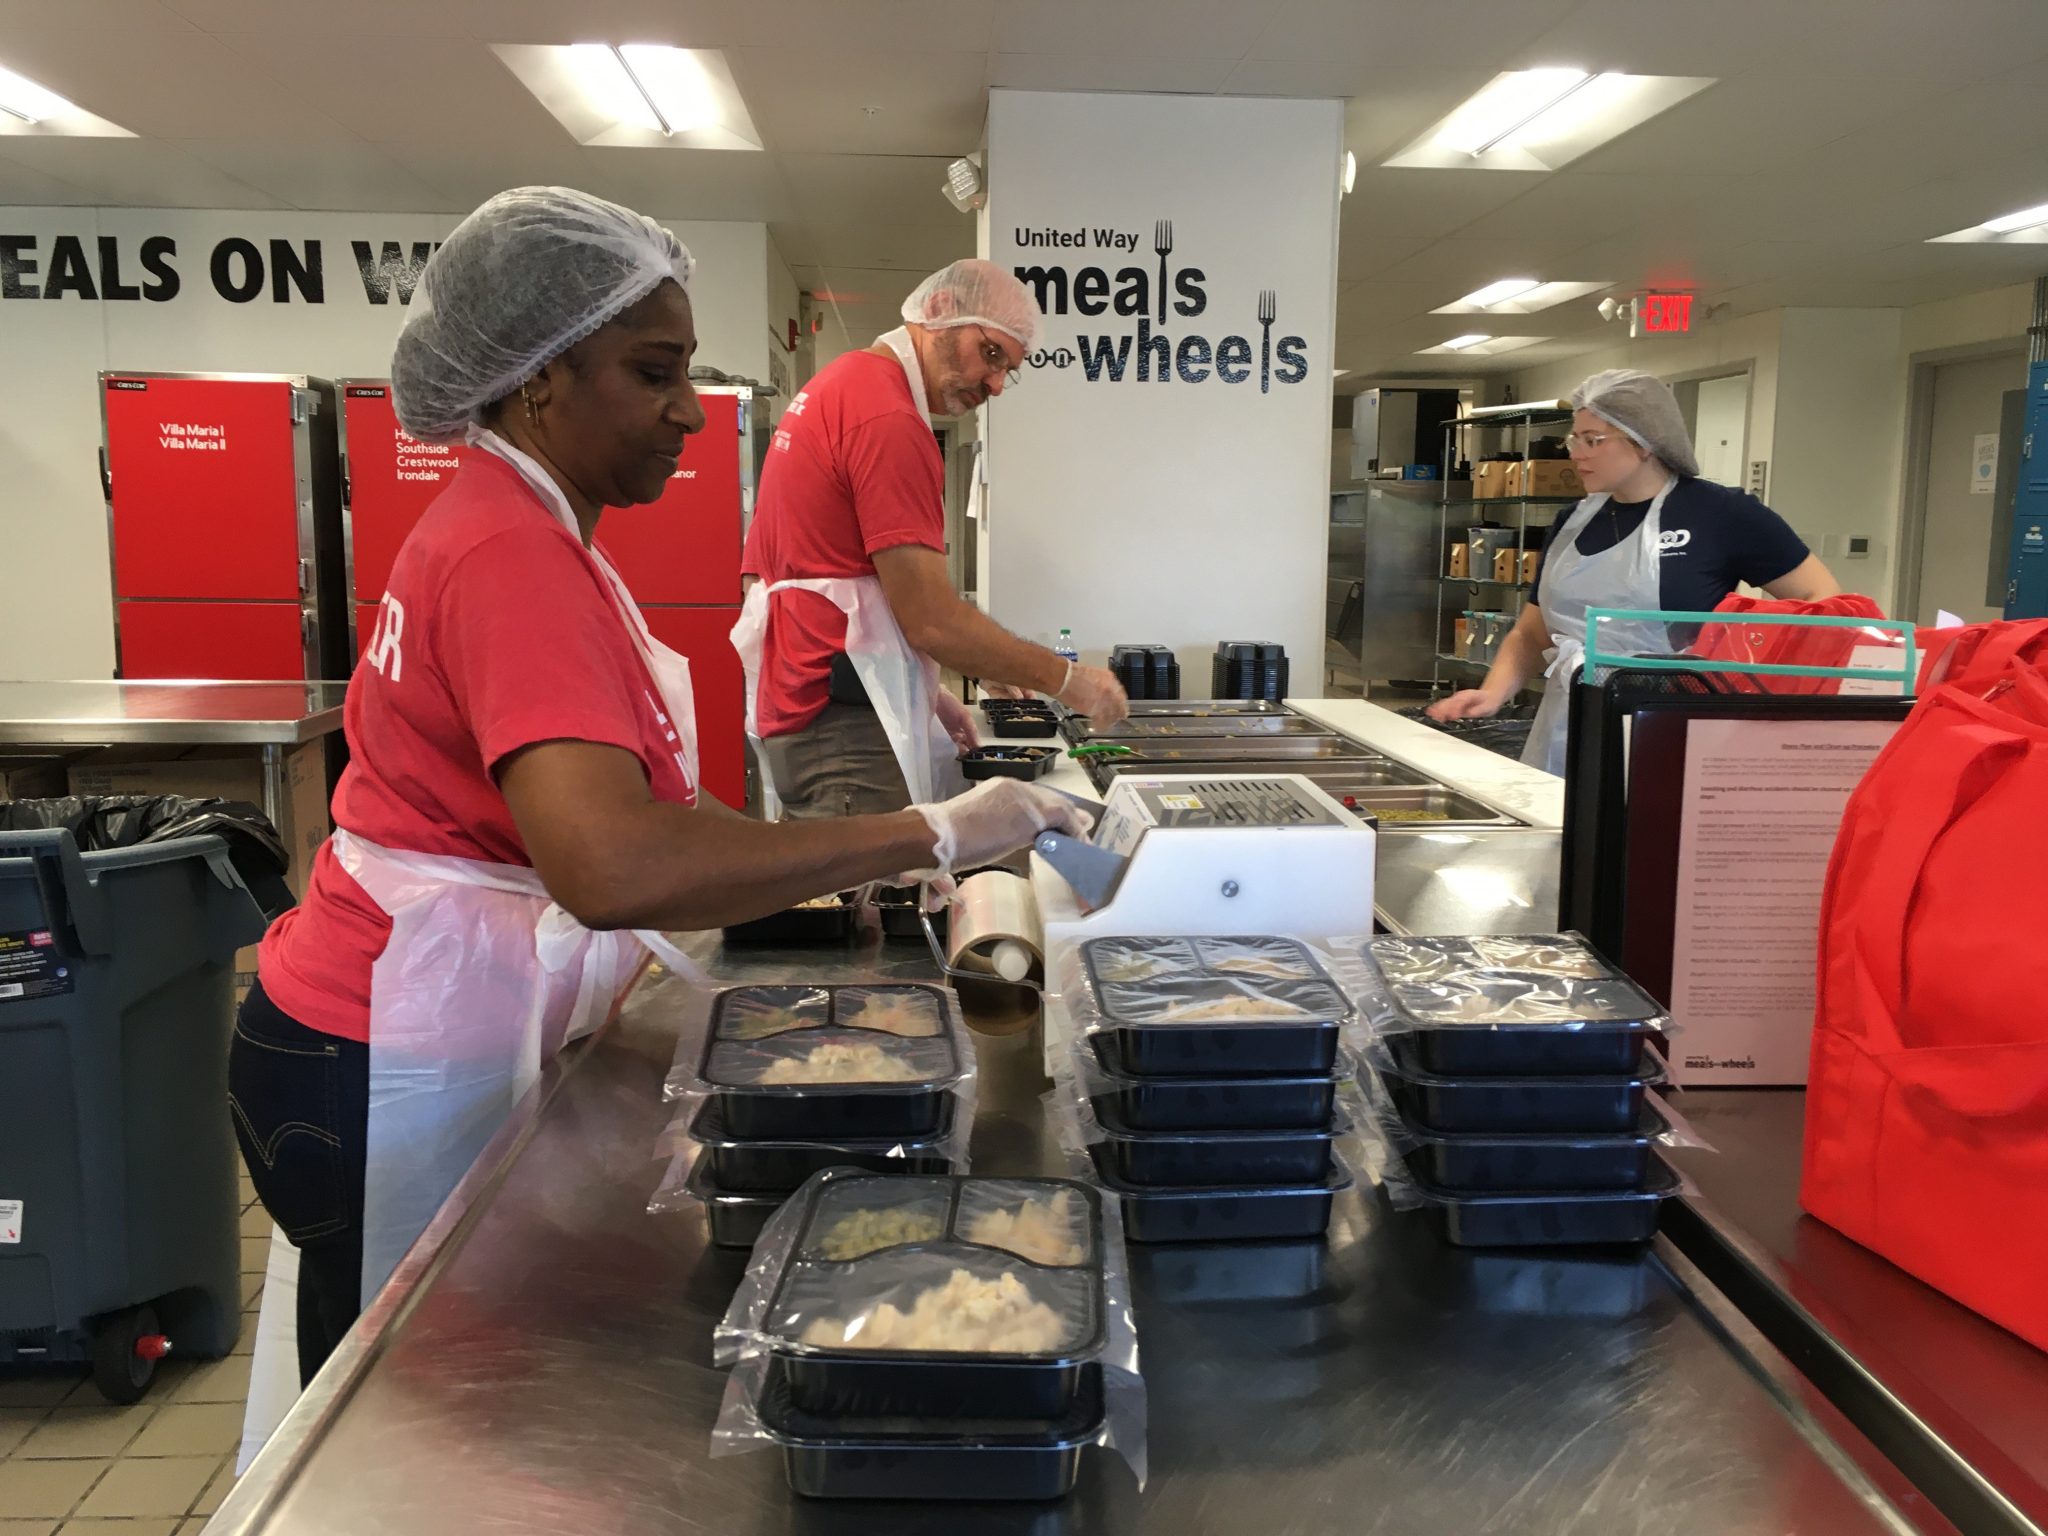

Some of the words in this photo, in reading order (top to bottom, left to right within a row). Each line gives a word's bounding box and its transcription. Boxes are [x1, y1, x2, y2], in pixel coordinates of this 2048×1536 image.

[1014, 227, 1086, 248] United
[1093, 228, 1140, 253] Way
[209, 237, 326, 304] ON
[1646, 295, 1694, 333] EXIT
[1076, 289, 1309, 395] wheels
[160, 423, 185, 435] Villa
[186, 424, 219, 436] Maria
[159, 437, 184, 449] Villa
[186, 438, 218, 450] Maria
[395, 442, 450, 455] Southside
[396, 455, 460, 468] Crestwood
[396, 468, 441, 481] Irondale
[671, 470, 697, 479] anor
